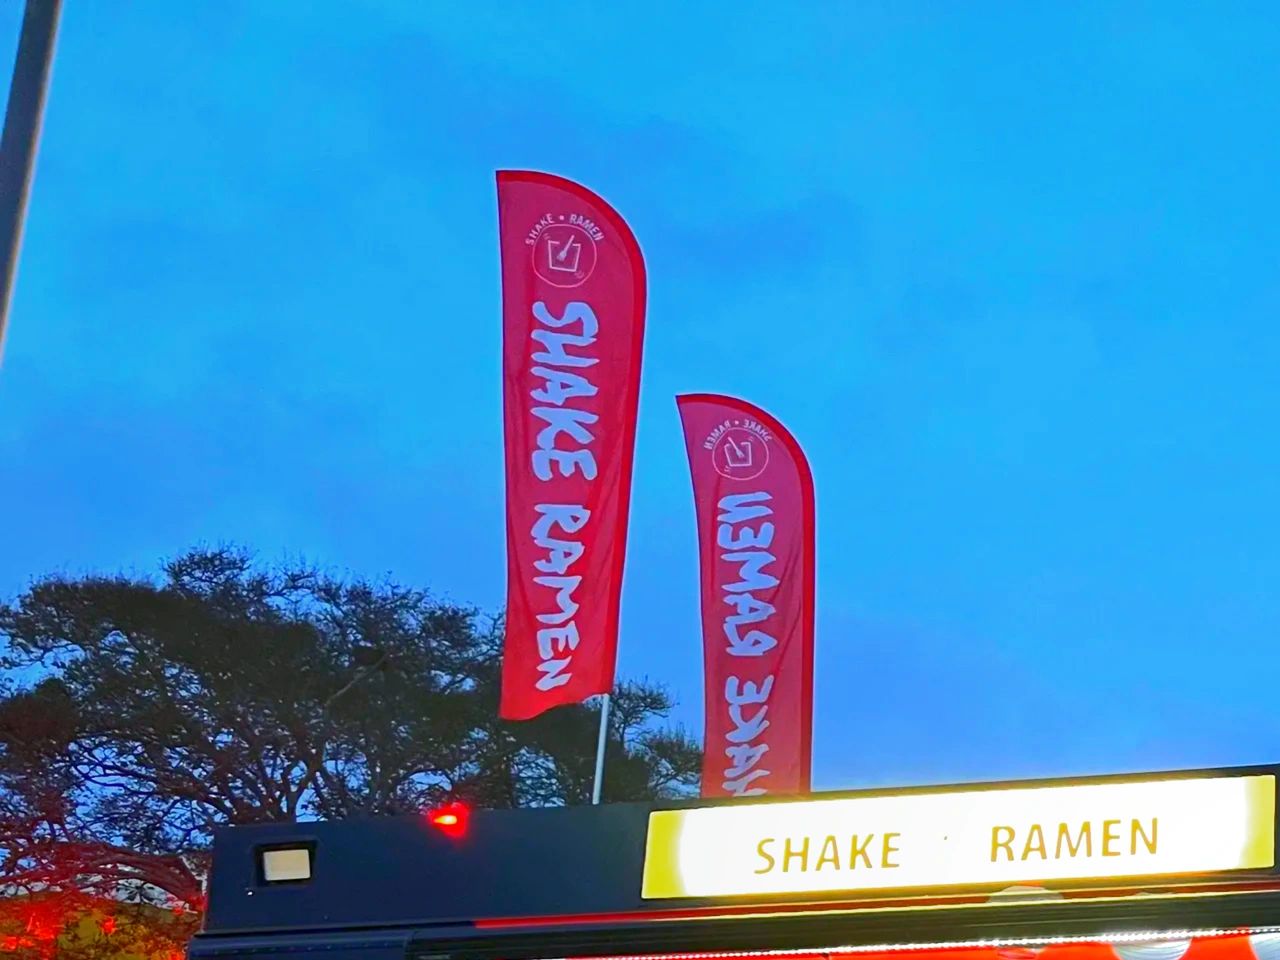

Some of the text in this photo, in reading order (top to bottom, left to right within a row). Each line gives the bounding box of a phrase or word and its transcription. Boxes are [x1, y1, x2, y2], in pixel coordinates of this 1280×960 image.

[525, 213, 605, 246] SHAKE RAMEN
[530, 300, 600, 692] SHAKE RAMEN
[753, 817, 1159, 875] SHAKE RAMEN
